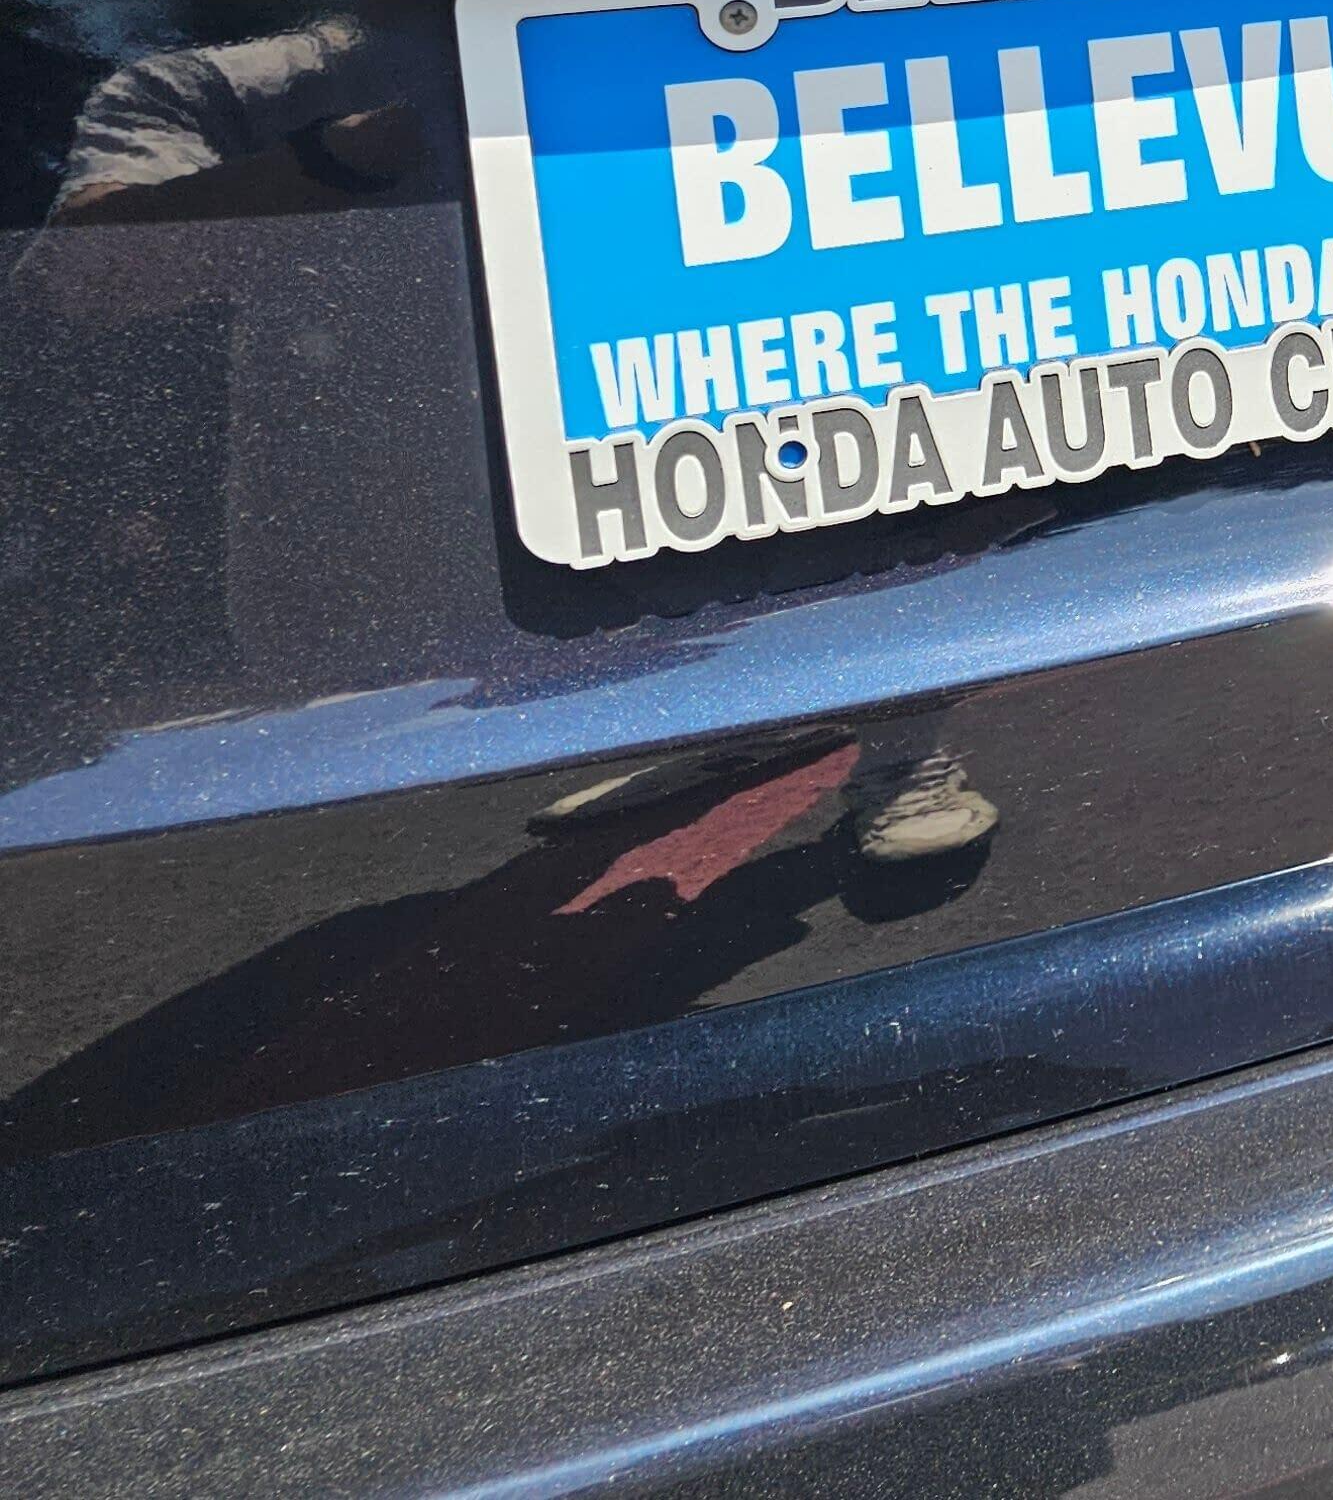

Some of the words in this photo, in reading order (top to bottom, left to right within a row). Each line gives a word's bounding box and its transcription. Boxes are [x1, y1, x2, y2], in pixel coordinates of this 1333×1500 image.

[589, 301, 903, 429] WHERE
[925, 276, 1078, 376] THE
[568, 395, 954, 560] HONDA
[982, 346, 1234, 488] AUTO
